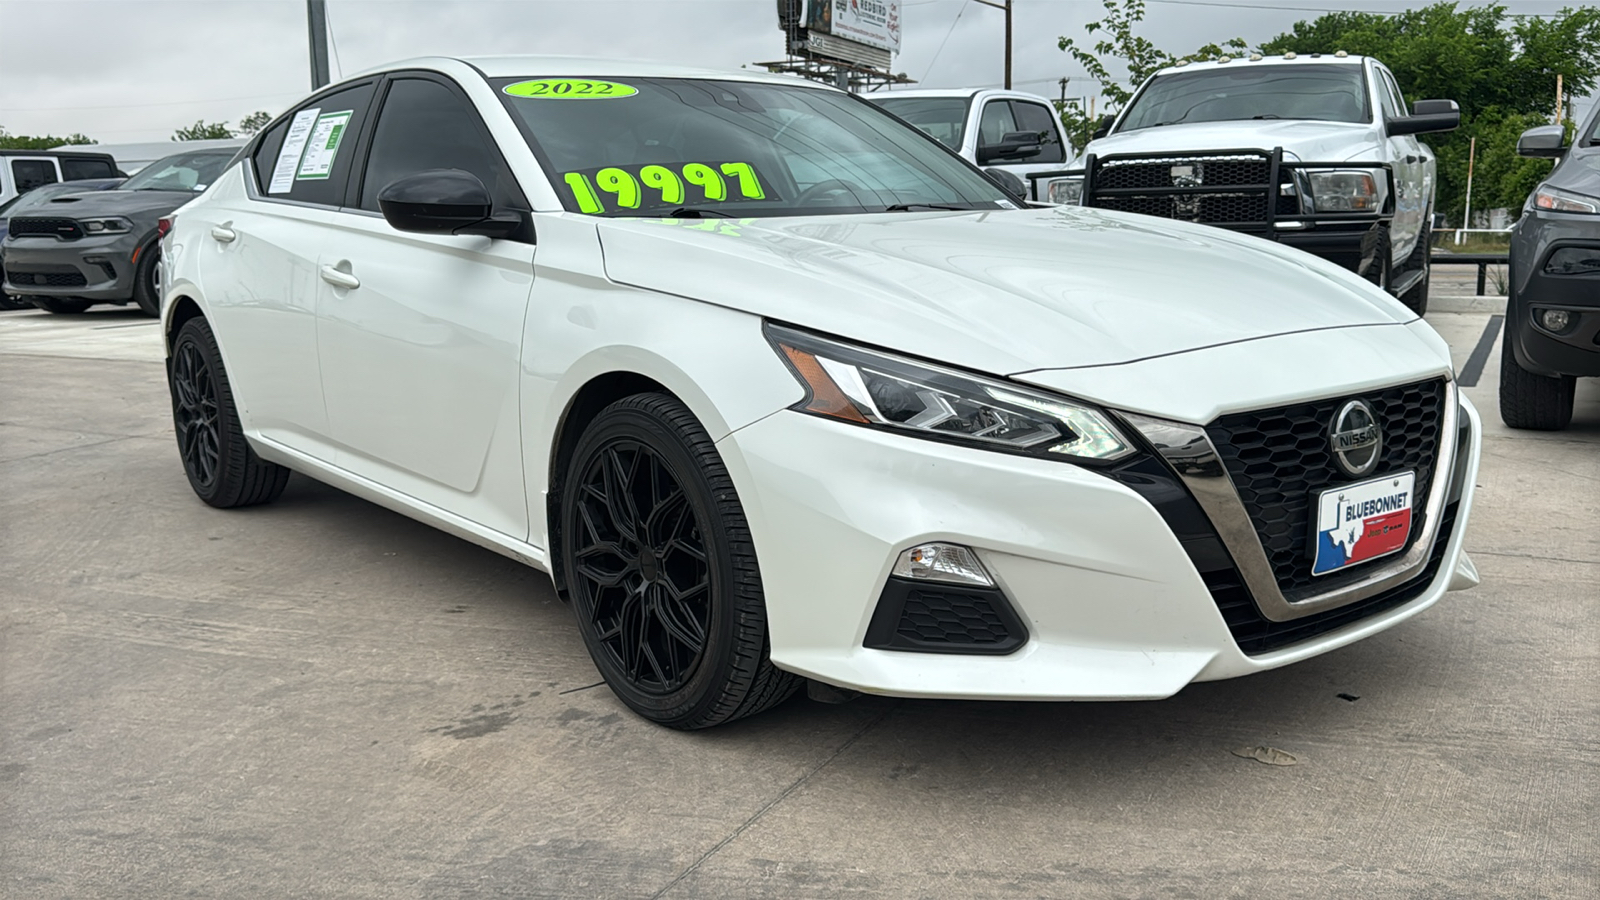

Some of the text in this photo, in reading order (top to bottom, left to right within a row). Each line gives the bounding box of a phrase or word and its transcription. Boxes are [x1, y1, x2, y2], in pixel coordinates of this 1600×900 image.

[811, 36, 823, 48] JGI
[530, 82, 614, 95] 2022
[564, 162, 766, 214] 19997
[1340, 429, 1379, 447] NISSAN
[1345, 492, 1408, 522] BLUEBONNET
